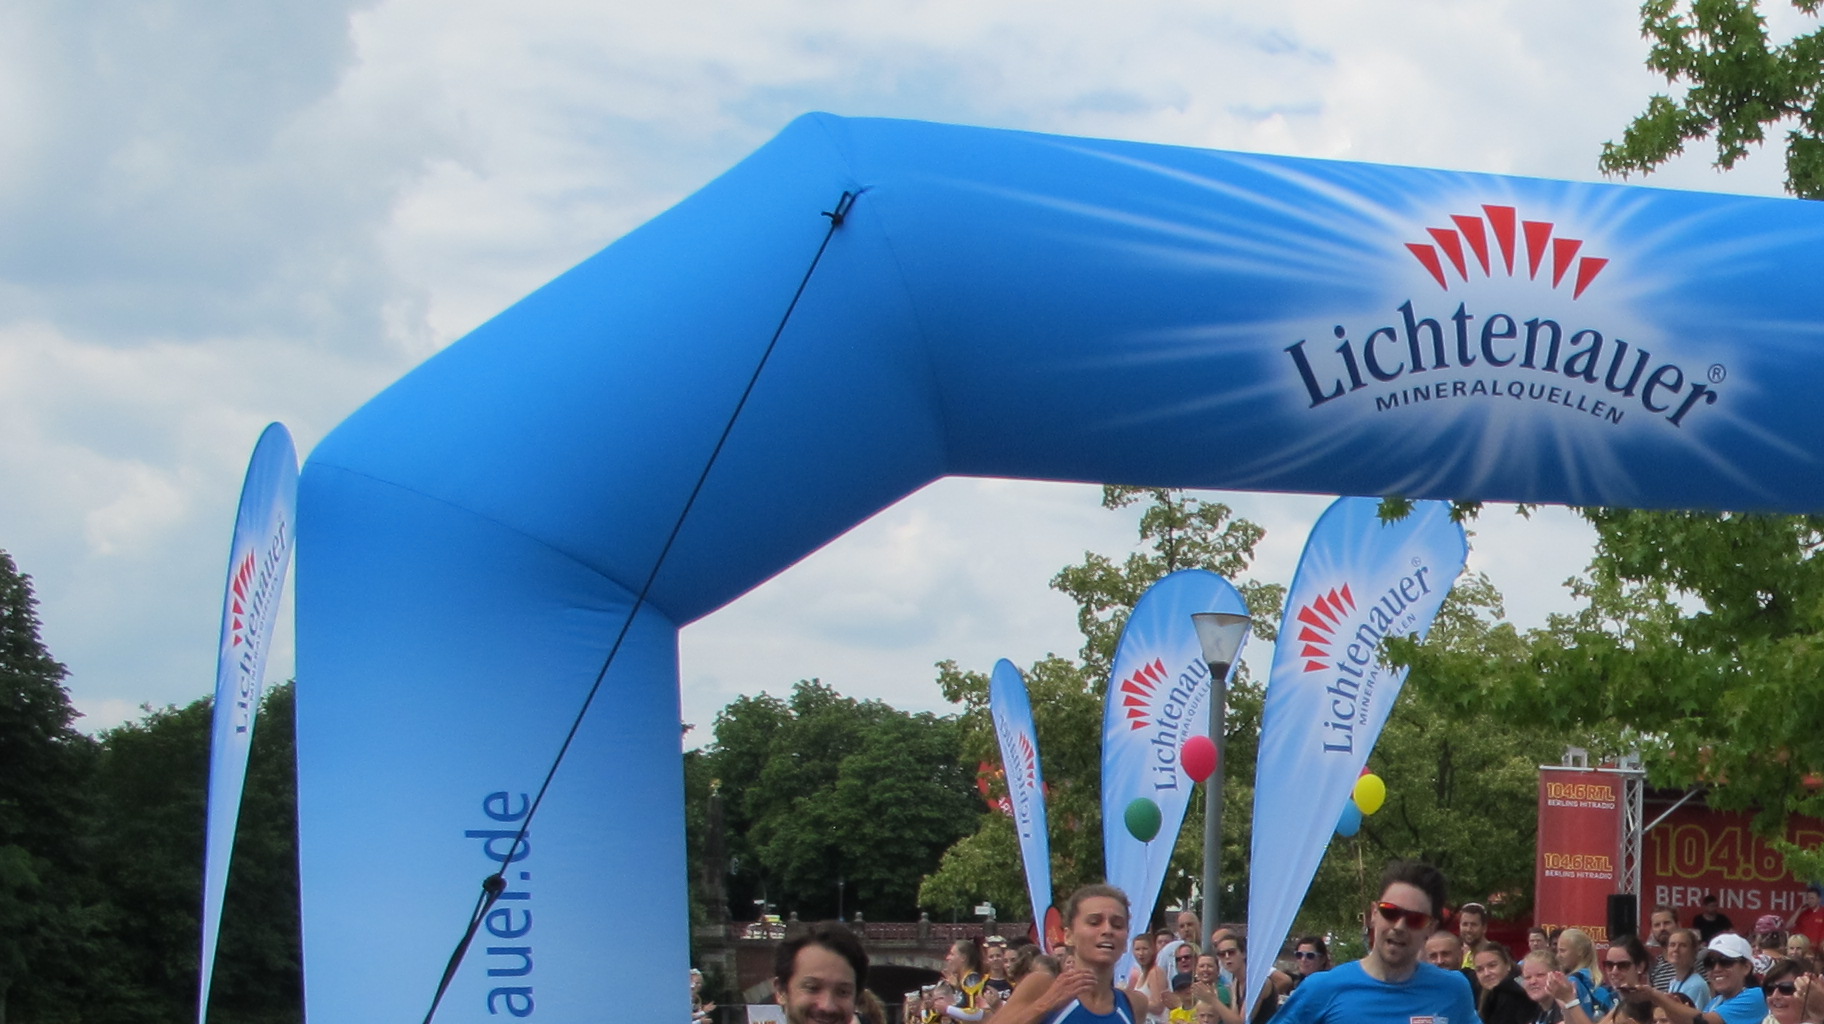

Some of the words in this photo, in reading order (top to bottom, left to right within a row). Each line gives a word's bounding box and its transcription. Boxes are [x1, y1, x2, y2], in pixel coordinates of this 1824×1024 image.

[1375, 379, 1625, 425] MINERALQUELLEN
[1358, 613, 1417, 727] MINERALLEN
[1150, 655, 1209, 792] Lichtenau
[1546, 782, 1585, 800] 104.6
[1586, 784, 1616, 802] RTL
[1580, 801, 1615, 810] HITRADIO
[1544, 852, 1582, 870] 104.6
[1583, 855, 1613, 872] RTL
[1652, 823, 1788, 882] 104.6
[1576, 871, 1613, 880] HITRADIO
